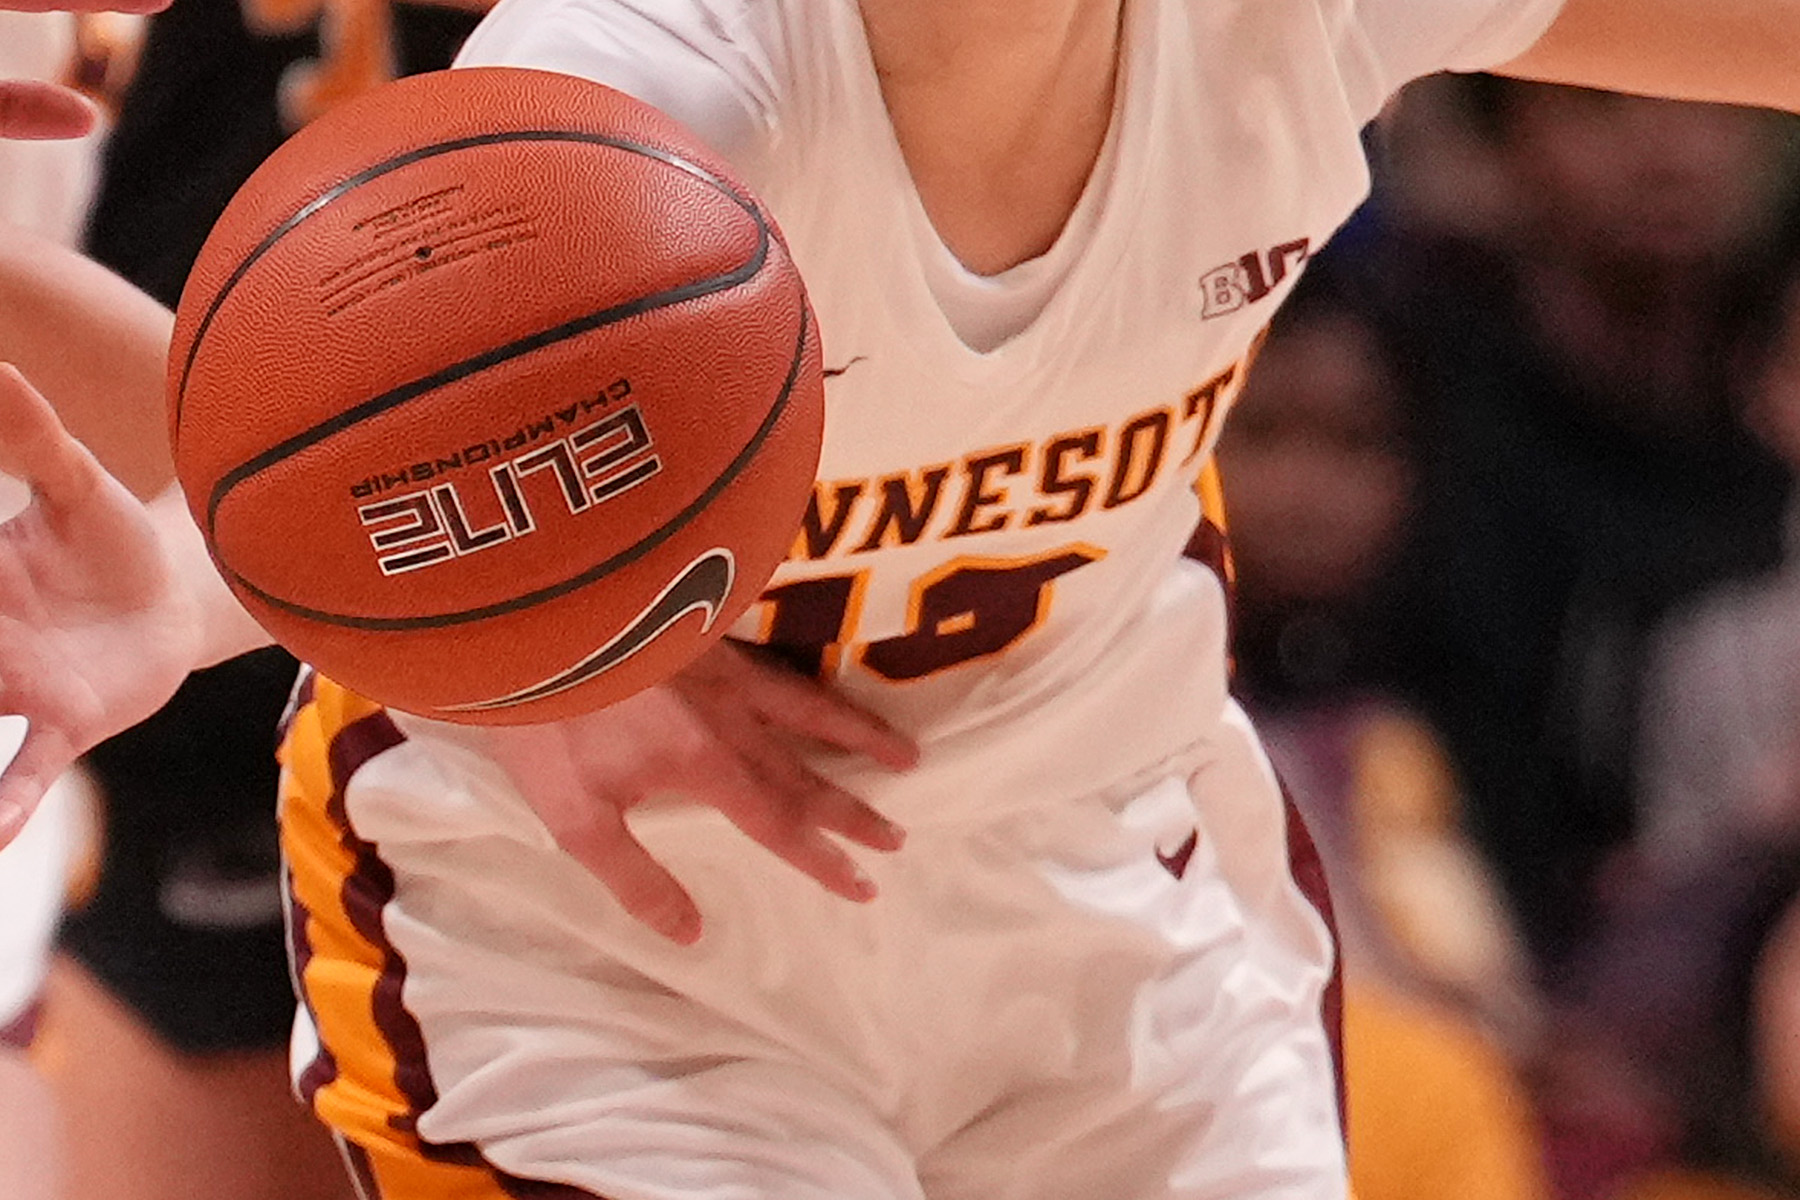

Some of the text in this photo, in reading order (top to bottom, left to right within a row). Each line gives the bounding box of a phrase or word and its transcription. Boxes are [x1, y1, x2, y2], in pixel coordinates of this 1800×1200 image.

[350, 377, 632, 499] CHAMPIONSHIP
[357, 401, 664, 578] ELITE
[783, 360, 1239, 564] NNESOT
